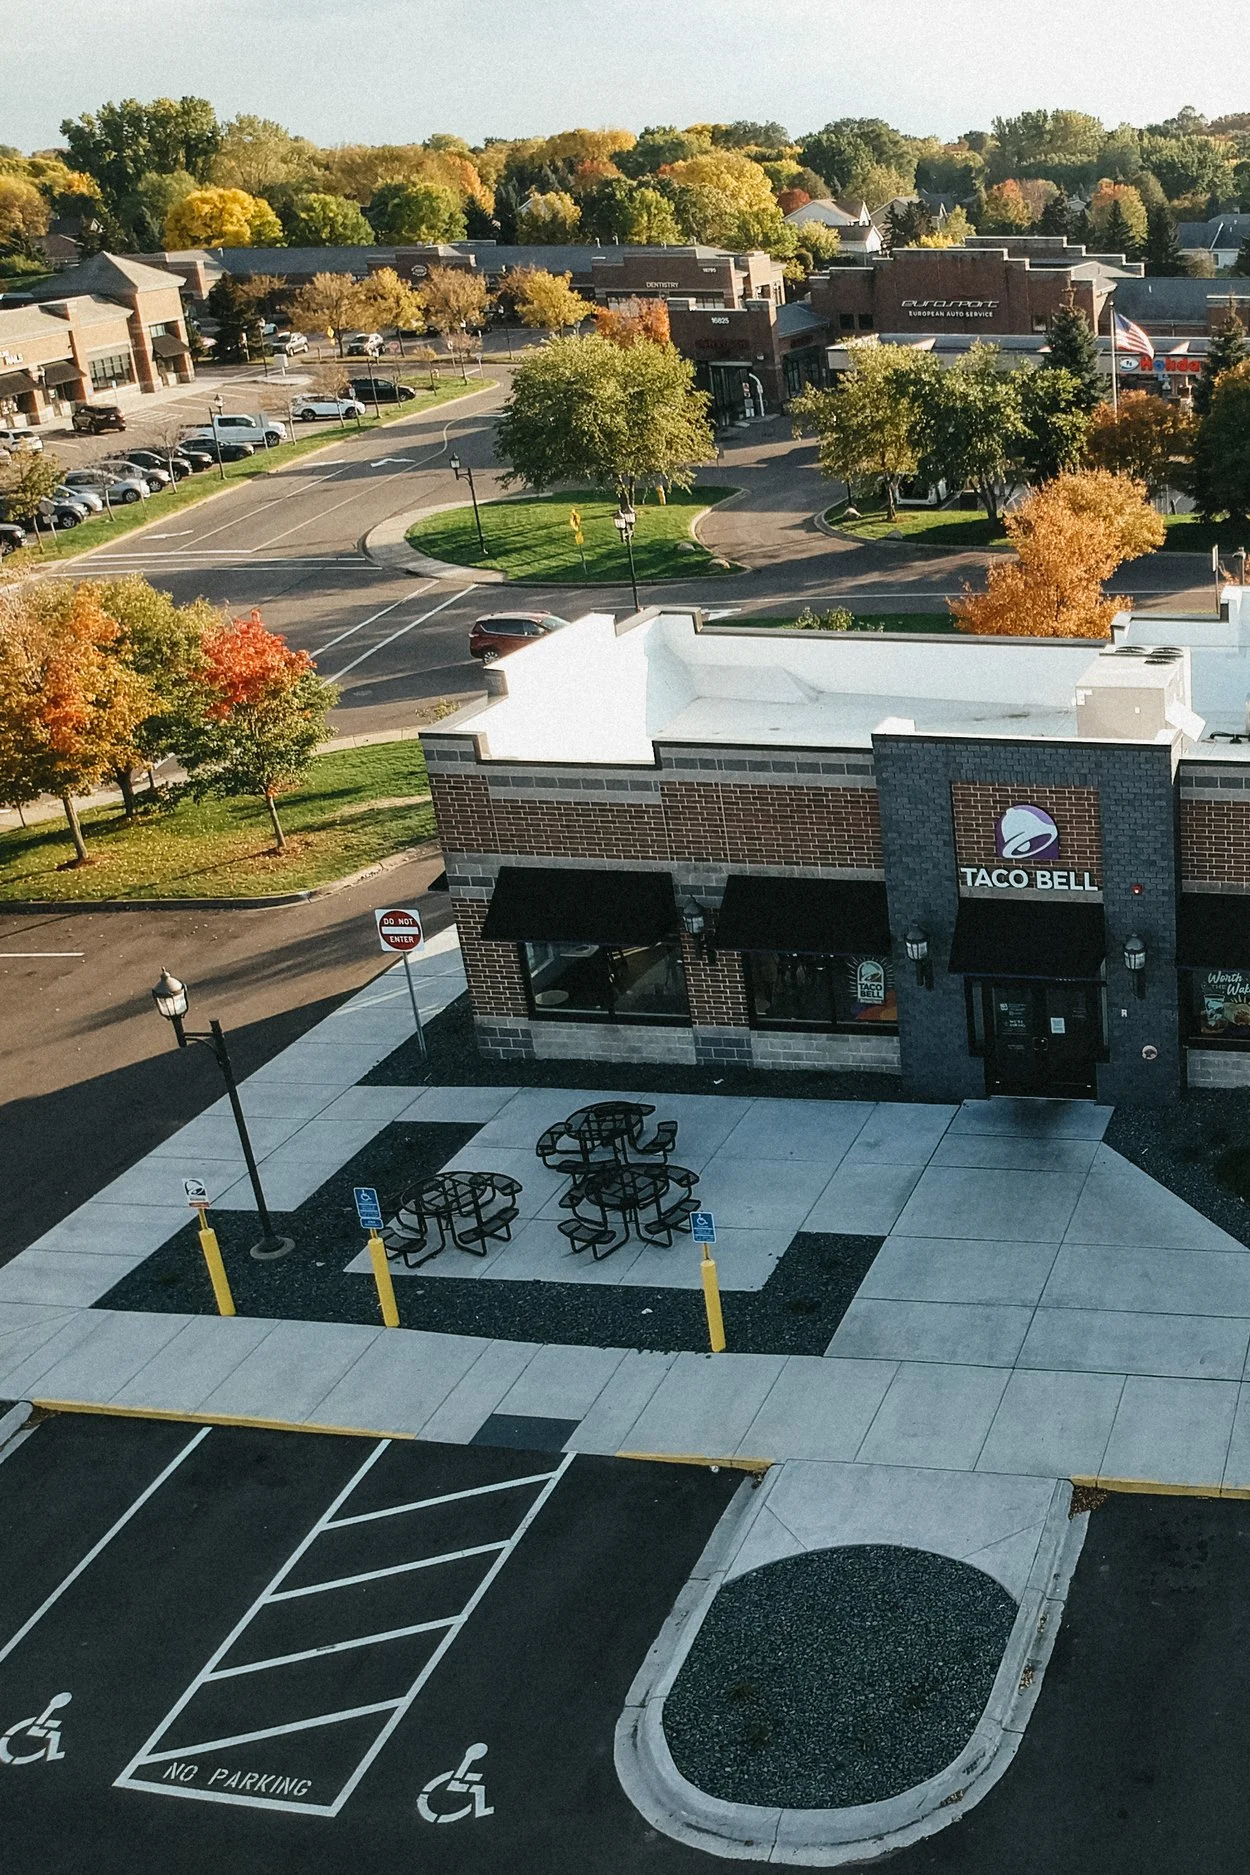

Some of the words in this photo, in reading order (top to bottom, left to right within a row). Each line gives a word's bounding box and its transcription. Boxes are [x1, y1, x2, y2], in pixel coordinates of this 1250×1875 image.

[1140, 357, 1200, 372] Holida
[960, 867, 1029, 889] TACO
[1036, 870, 1099, 892] BELL
[1208, 971, 1242, 983] Worth
[859, 983, 883, 991] TACO
[860, 990, 882, 998] BELL
[162, 1762, 199, 1782] NO
[208, 1768, 312, 1796] PARKING
